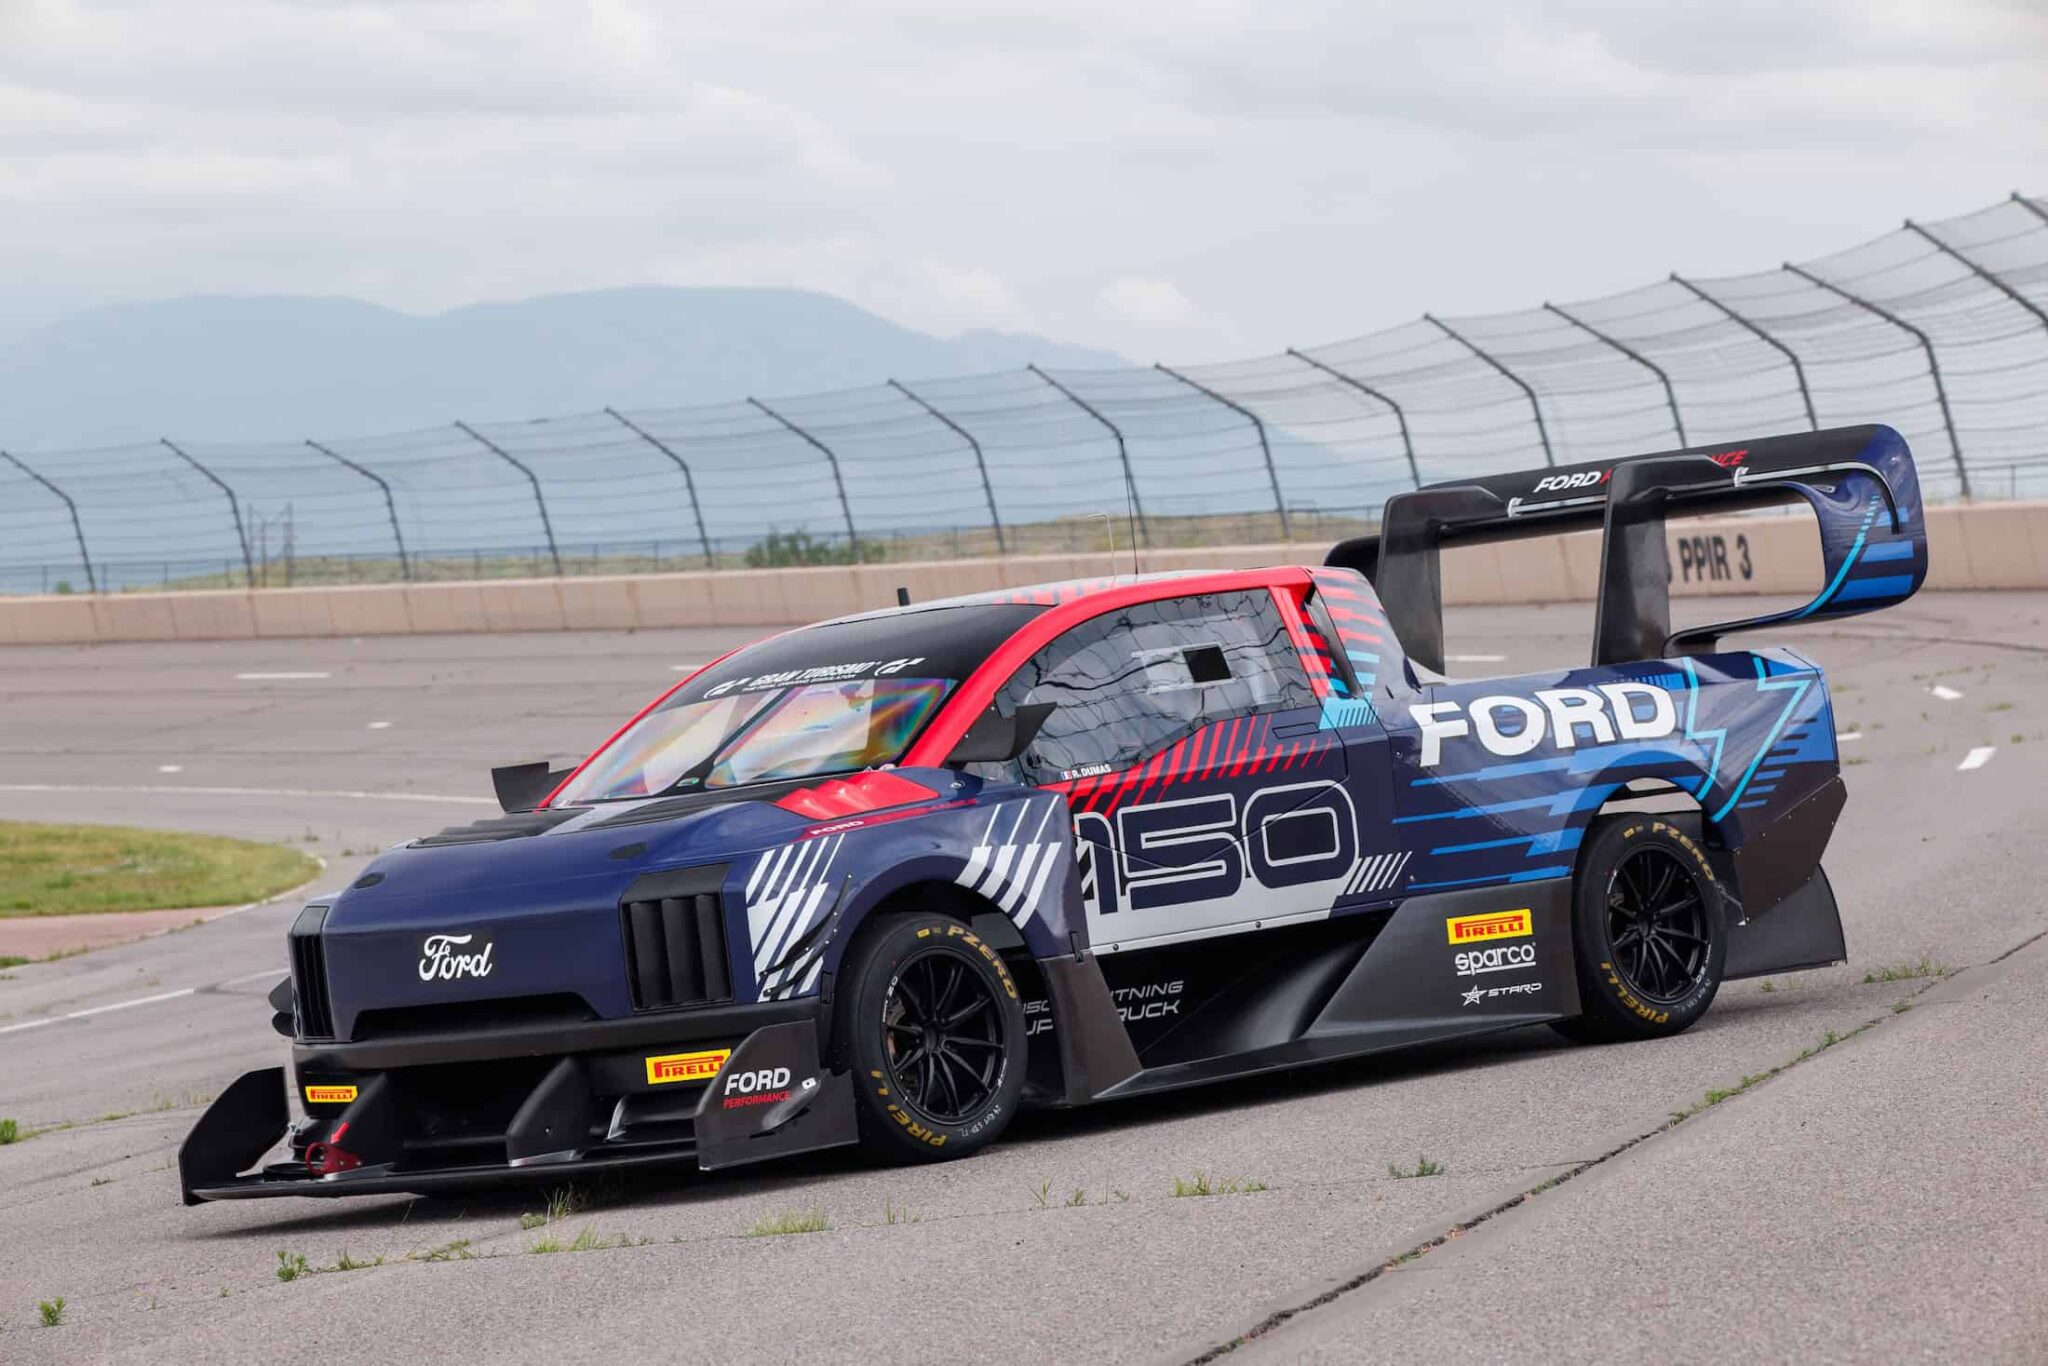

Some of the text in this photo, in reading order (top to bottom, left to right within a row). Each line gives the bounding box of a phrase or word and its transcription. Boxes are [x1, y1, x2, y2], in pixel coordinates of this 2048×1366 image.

[1533, 471, 1602, 494] FORD
[1677, 536, 1731, 582] PPIR
[1736, 533, 1753, 581] 3
[1409, 681, 1677, 768] FORD
[1080, 763, 1112, 777] DUMAS
[811, 820, 856, 836] FORD
[1455, 915, 1524, 939] PIRELLI
[418, 934, 493, 981] Ford
[1455, 944, 1536, 976] sparco
[1110, 980, 1184, 1002] TNING
[1487, 982, 1542, 997] STARD
[1116, 999, 1181, 1022] RUCK
[654, 1055, 726, 1078] PIRELLI
[724, 1067, 791, 1095] FORD
[310, 1089, 353, 1100] PIRELLI
[723, 1091, 791, 1109] PERFORMANCE
